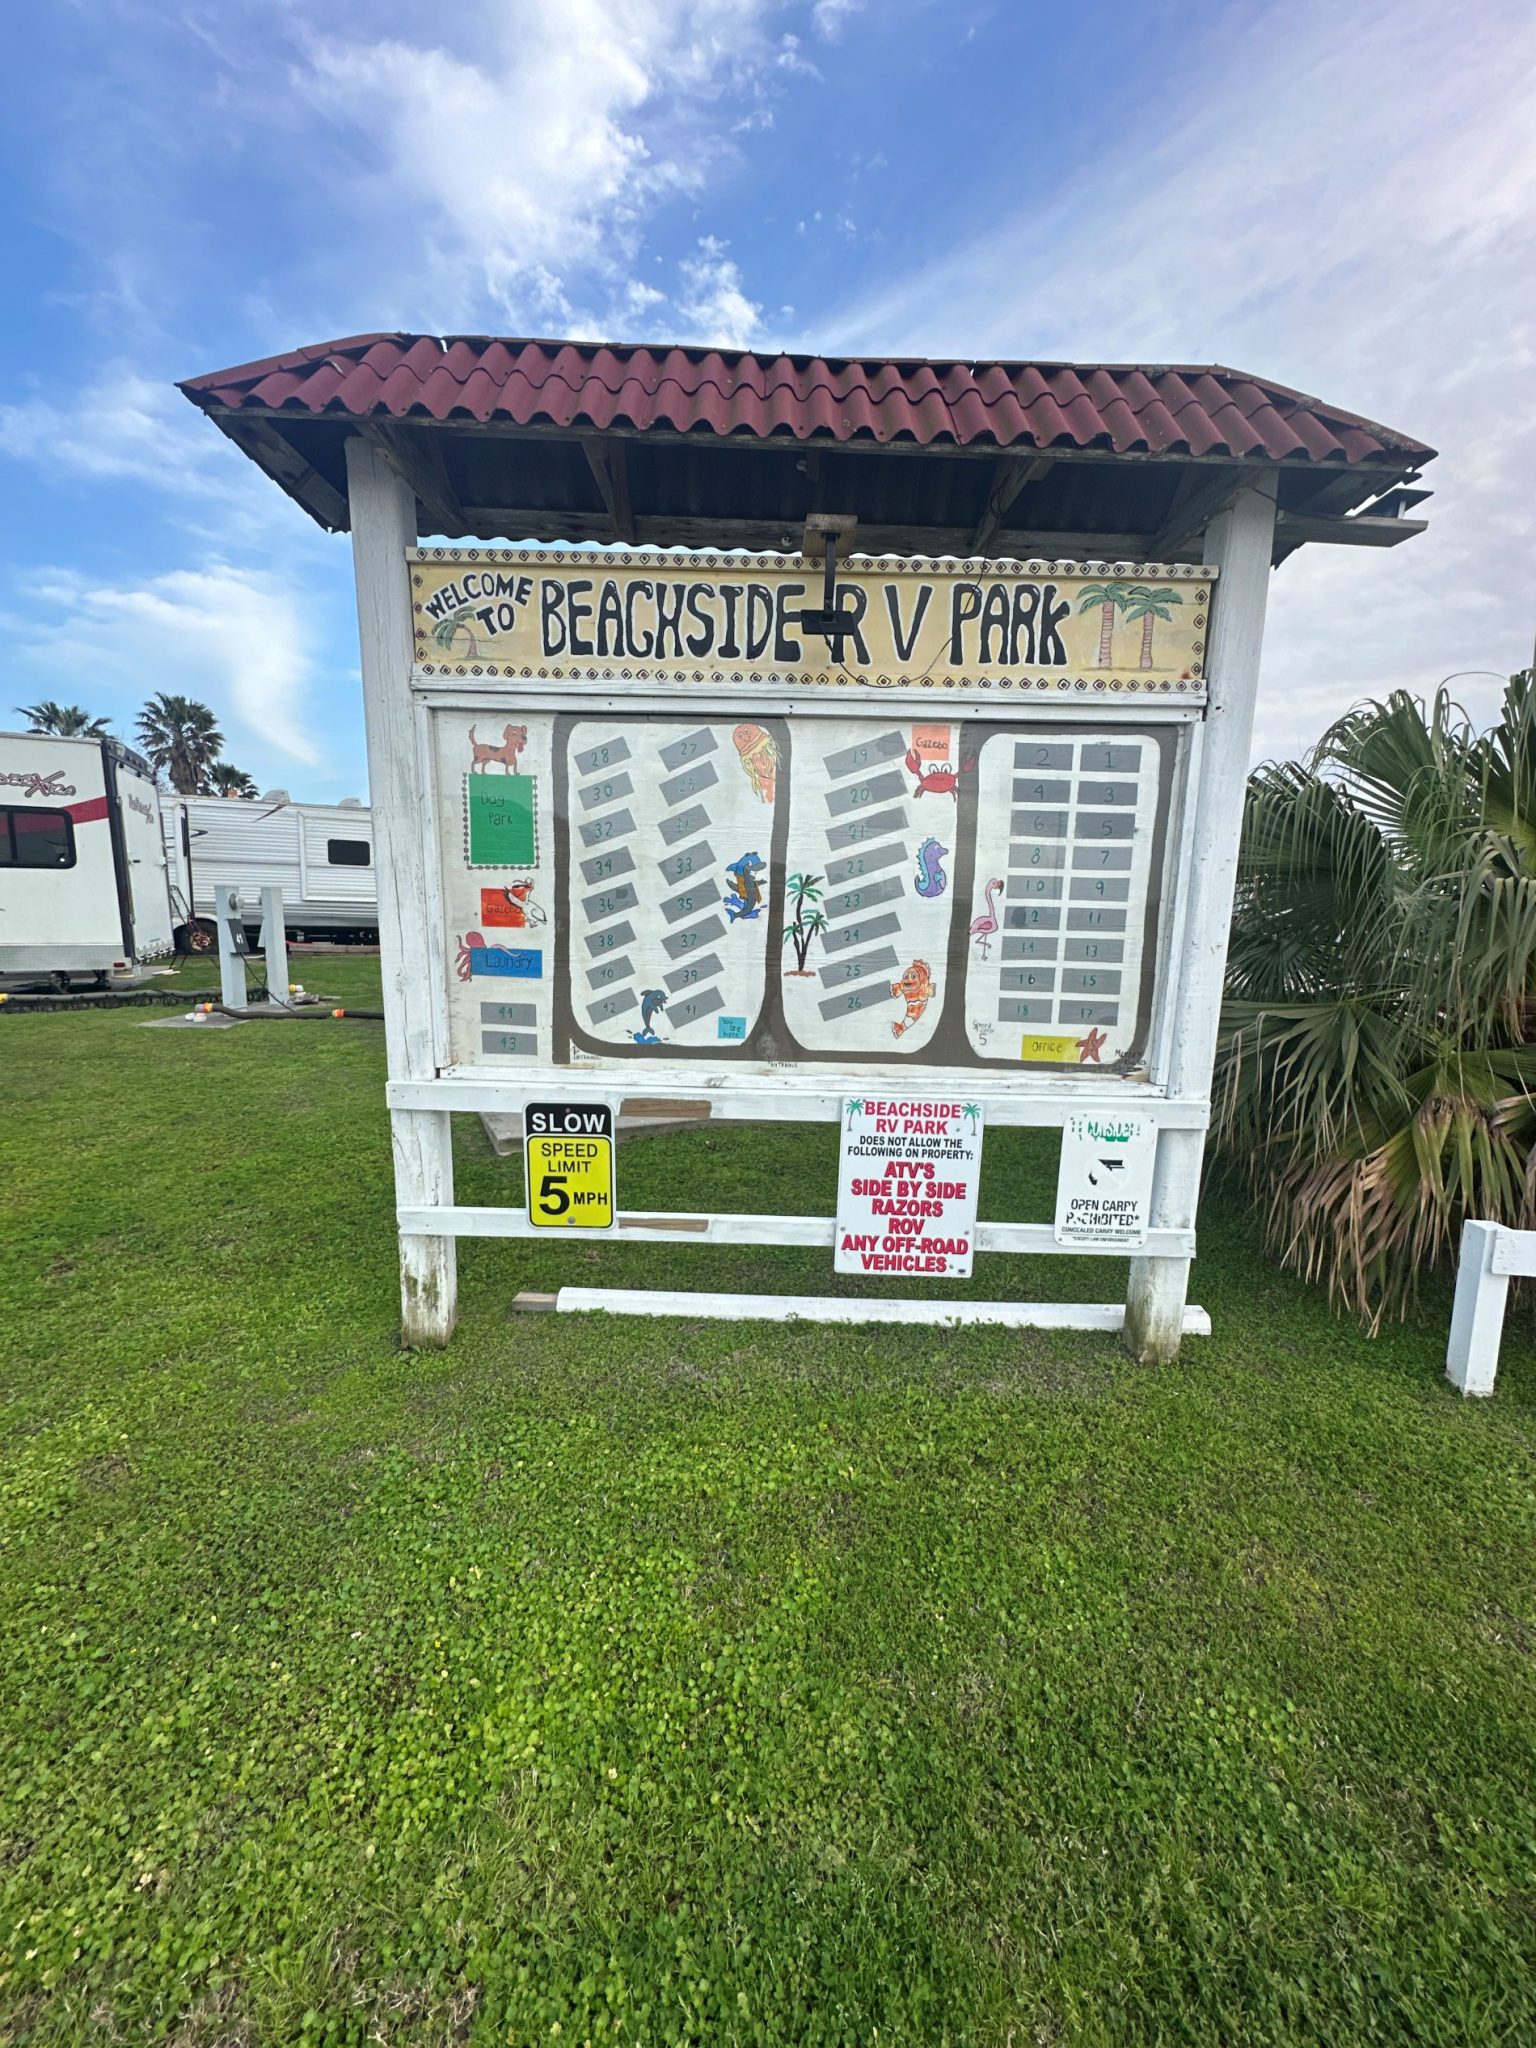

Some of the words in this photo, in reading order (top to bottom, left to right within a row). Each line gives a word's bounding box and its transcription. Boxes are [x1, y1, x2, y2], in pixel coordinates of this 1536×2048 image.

[425, 572, 534, 620] WELCOME
[477, 603, 515, 636] TO
[541, 579, 806, 662] BEACHSIDE
[949, 582, 1071, 665] PARK
[681, 742, 698, 756] 27
[853, 749, 868, 764] 19
[1035, 748, 1051, 766] 2
[591, 748, 609, 768] 28
[1104, 751, 1116, 769] 1
[481, 791, 505, 808] Dog
[593, 785, 613, 801] 30
[850, 787, 870, 804] 20
[1033, 784, 1045, 801] 4
[1104, 786, 1115, 803] 3
[594, 821, 613, 839] 32
[1033, 816, 1044, 831] 6
[1101, 819, 1113, 836] 5
[850, 824, 865, 840] 21
[1031, 847, 1041, 865] 8
[1100, 850, 1110, 865] 7
[595, 859, 612, 877] 34
[676, 857, 692, 874] 33
[847, 860, 865, 874] 22
[1025, 879, 1045, 892] 10
[1095, 880, 1105, 896] 9
[598, 897, 614, 912] 36
[677, 897, 693, 912] 35
[845, 893, 860, 908] 23
[1023, 910, 1039, 924] 12
[1088, 911, 1101, 924] 11
[598, 934, 614, 947] 38
[681, 934, 697, 948] 37
[844, 929, 860, 942] 24
[1021, 941, 1034, 953] 14
[1085, 944, 1098, 958] 13
[486, 953, 533, 971] Laundry
[846, 964, 861, 976] 25
[682, 970, 698, 983] 39
[1019, 973, 1036, 985] 16
[1082, 974, 1097, 987] 15
[603, 1002, 616, 1014] 42
[847, 997, 862, 1010] 26
[1017, 1004, 1029, 1016] 18
[1080, 1006, 1093, 1019] 17
[979, 1033, 987, 1046] 5
[864, 1101, 962, 1119] BEACHSIDE
[531, 1112, 606, 1133] SLOW
[876, 1119, 899, 1133] RV
[903, 1119, 949, 1135] PARK
[541, 1142, 598, 1158] SPEED
[860, 1135, 885, 1146] DOES
[888, 1136, 908, 1147] NOT
[909, 1137, 942, 1148] ALLOW
[944, 1138, 963, 1149] THE
[847, 1145, 903, 1158] FOLLOWING
[905, 1147, 919, 1158] ON
[921, 1149, 974, 1161] PROPERTY:
[548, 1160, 592, 1173] LIMIT
[884, 1160, 935, 1180] ATV'S
[539, 1175, 570, 1216] 5
[573, 1192, 608, 1205] MPH
[851, 1178, 893, 1197] SIDE
[897, 1180, 923, 1198] BY
[925, 1181, 967, 1200] SIDE
[871, 1198, 944, 1217] RAZORS
[888, 1217, 925, 1235] ROV
[841, 1234, 880, 1251] ANY
[882, 1236, 969, 1256] OFF-ROAD
[860, 1253, 947, 1273] VEHICLES
